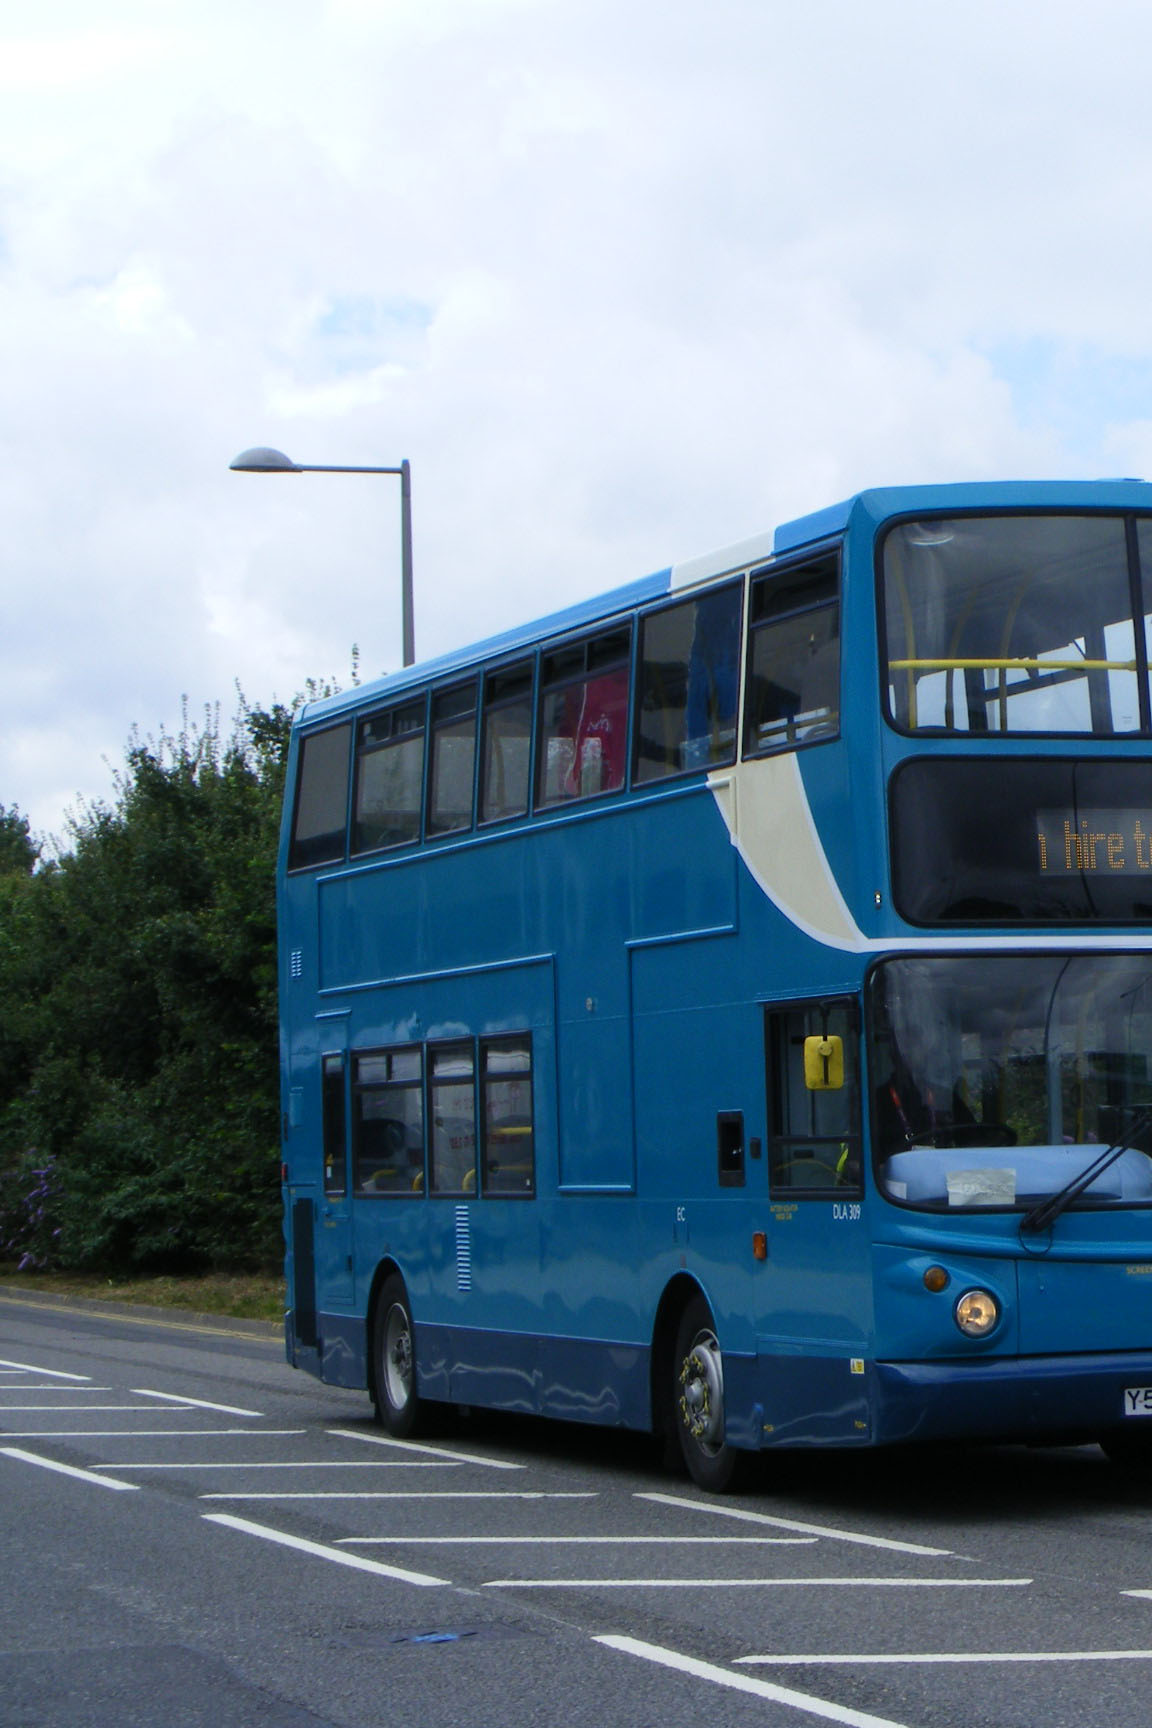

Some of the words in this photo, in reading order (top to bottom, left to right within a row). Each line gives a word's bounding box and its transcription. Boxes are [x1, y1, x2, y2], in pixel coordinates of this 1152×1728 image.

[1064, 820, 1125, 869] hire
[832, 1203, 848, 1220] DLA
[849, 1203, 862, 1220] 309
